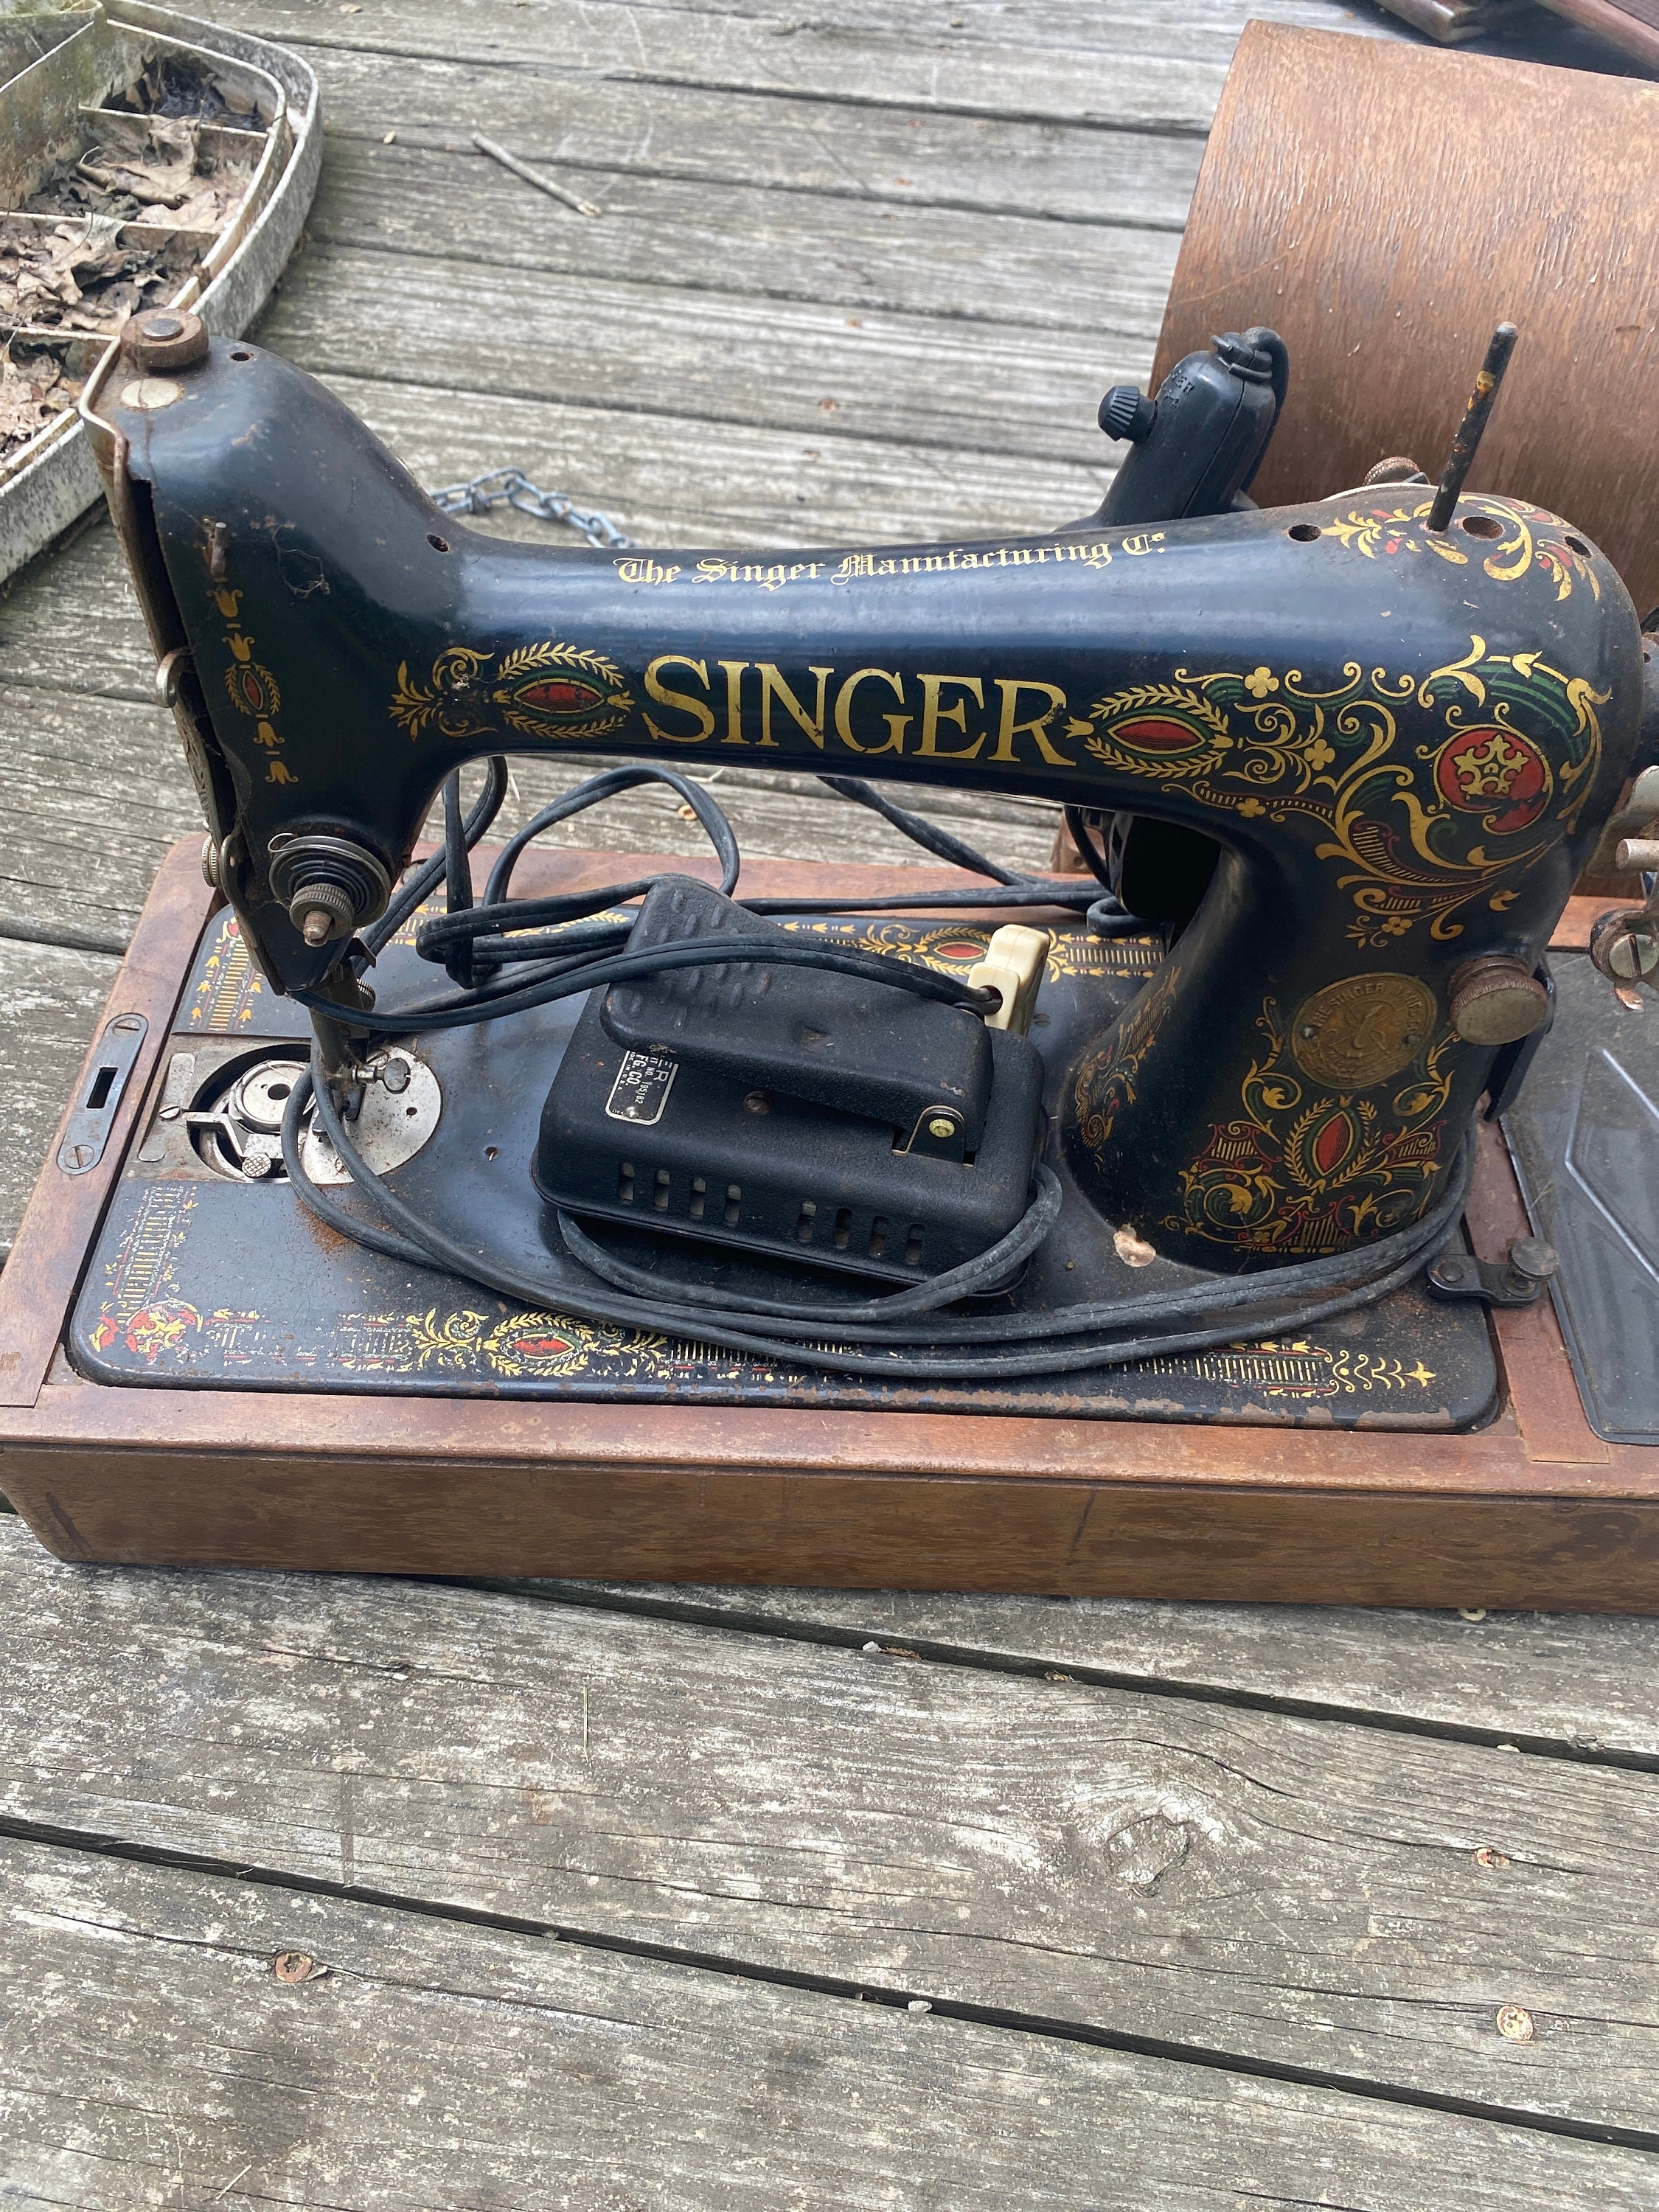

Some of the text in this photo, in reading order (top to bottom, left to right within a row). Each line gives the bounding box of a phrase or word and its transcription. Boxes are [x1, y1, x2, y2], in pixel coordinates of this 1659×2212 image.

[613, 557, 683, 586] The
[692, 557, 826, 592] Singer
[830, 543, 1113, 585] Manufacturing
[641, 654, 1077, 767] SINGER
[1329, 981, 1385, 1009] SINGER
[625, 1054, 649, 1086] FG. CO.
[644, 1066, 655, 1077] NO.
[634, 1081, 650, 1105] 195182
